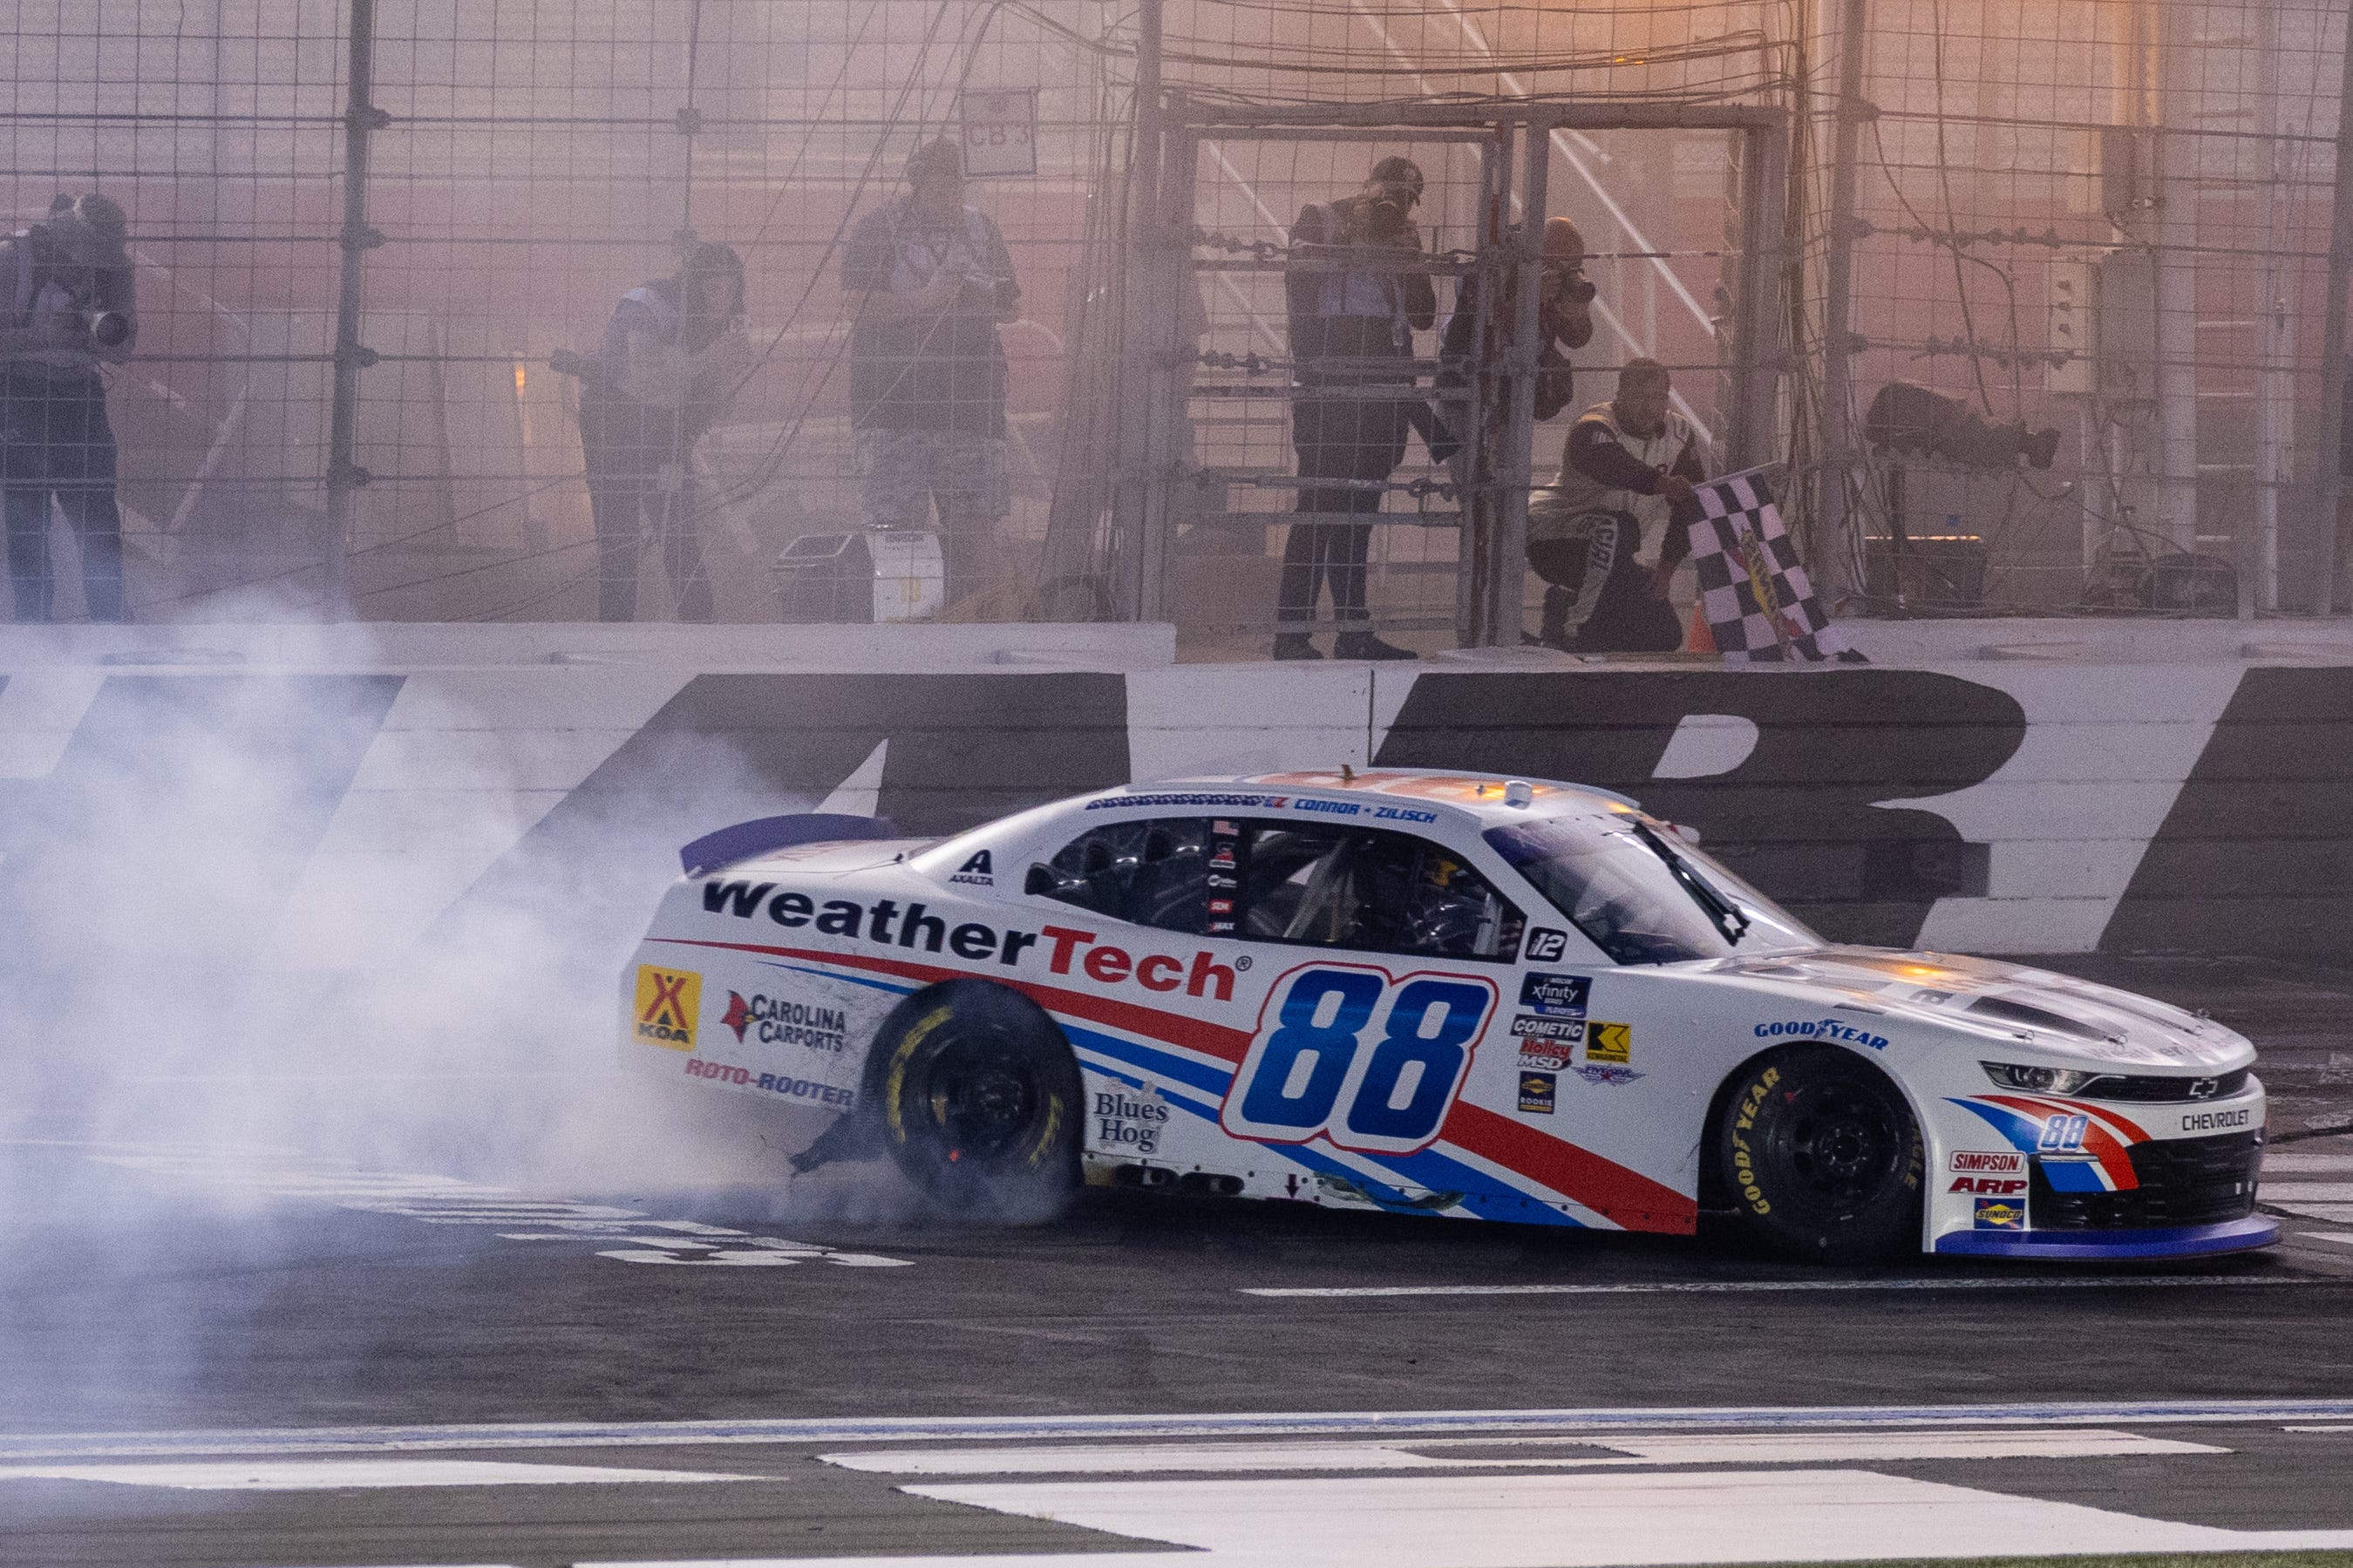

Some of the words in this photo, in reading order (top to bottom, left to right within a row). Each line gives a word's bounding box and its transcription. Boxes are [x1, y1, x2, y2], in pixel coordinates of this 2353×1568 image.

[1295, 799, 1360, 815] CONNOR
[1375, 807, 1437, 823] ZILISCH
[950, 875, 993, 886] AXALTA
[1530, 933, 1565, 957] 12
[1533, 984, 1578, 1002] xfinity
[750, 994, 846, 1035] CAROLINA
[638, 1022, 691, 1045] KOA
[759, 1021, 845, 1053] CARPORTS
[1513, 1019, 1583, 1037] COMETIC
[1754, 1019, 1888, 1050] GOODYEAR
[1241, 968, 1489, 1140] 88
[1521, 1039, 1573, 1060] Holley
[1519, 1056, 1562, 1069] MSD
[684, 1058, 854, 1105] ROTO-ROOTER
[1094, 1093, 1168, 1122] Blues
[2182, 1110, 2249, 1131] CHEVROLET
[1098, 1117, 1154, 1152] Hog
[1733, 1068, 1779, 1214] GOODYEAR
[2038, 1115, 2088, 1151] 88
[1954, 1154, 2020, 1171] SIMPSON
[1948, 1177, 2028, 1194] ARP
[1976, 1208, 2023, 1220] SUNOCO
